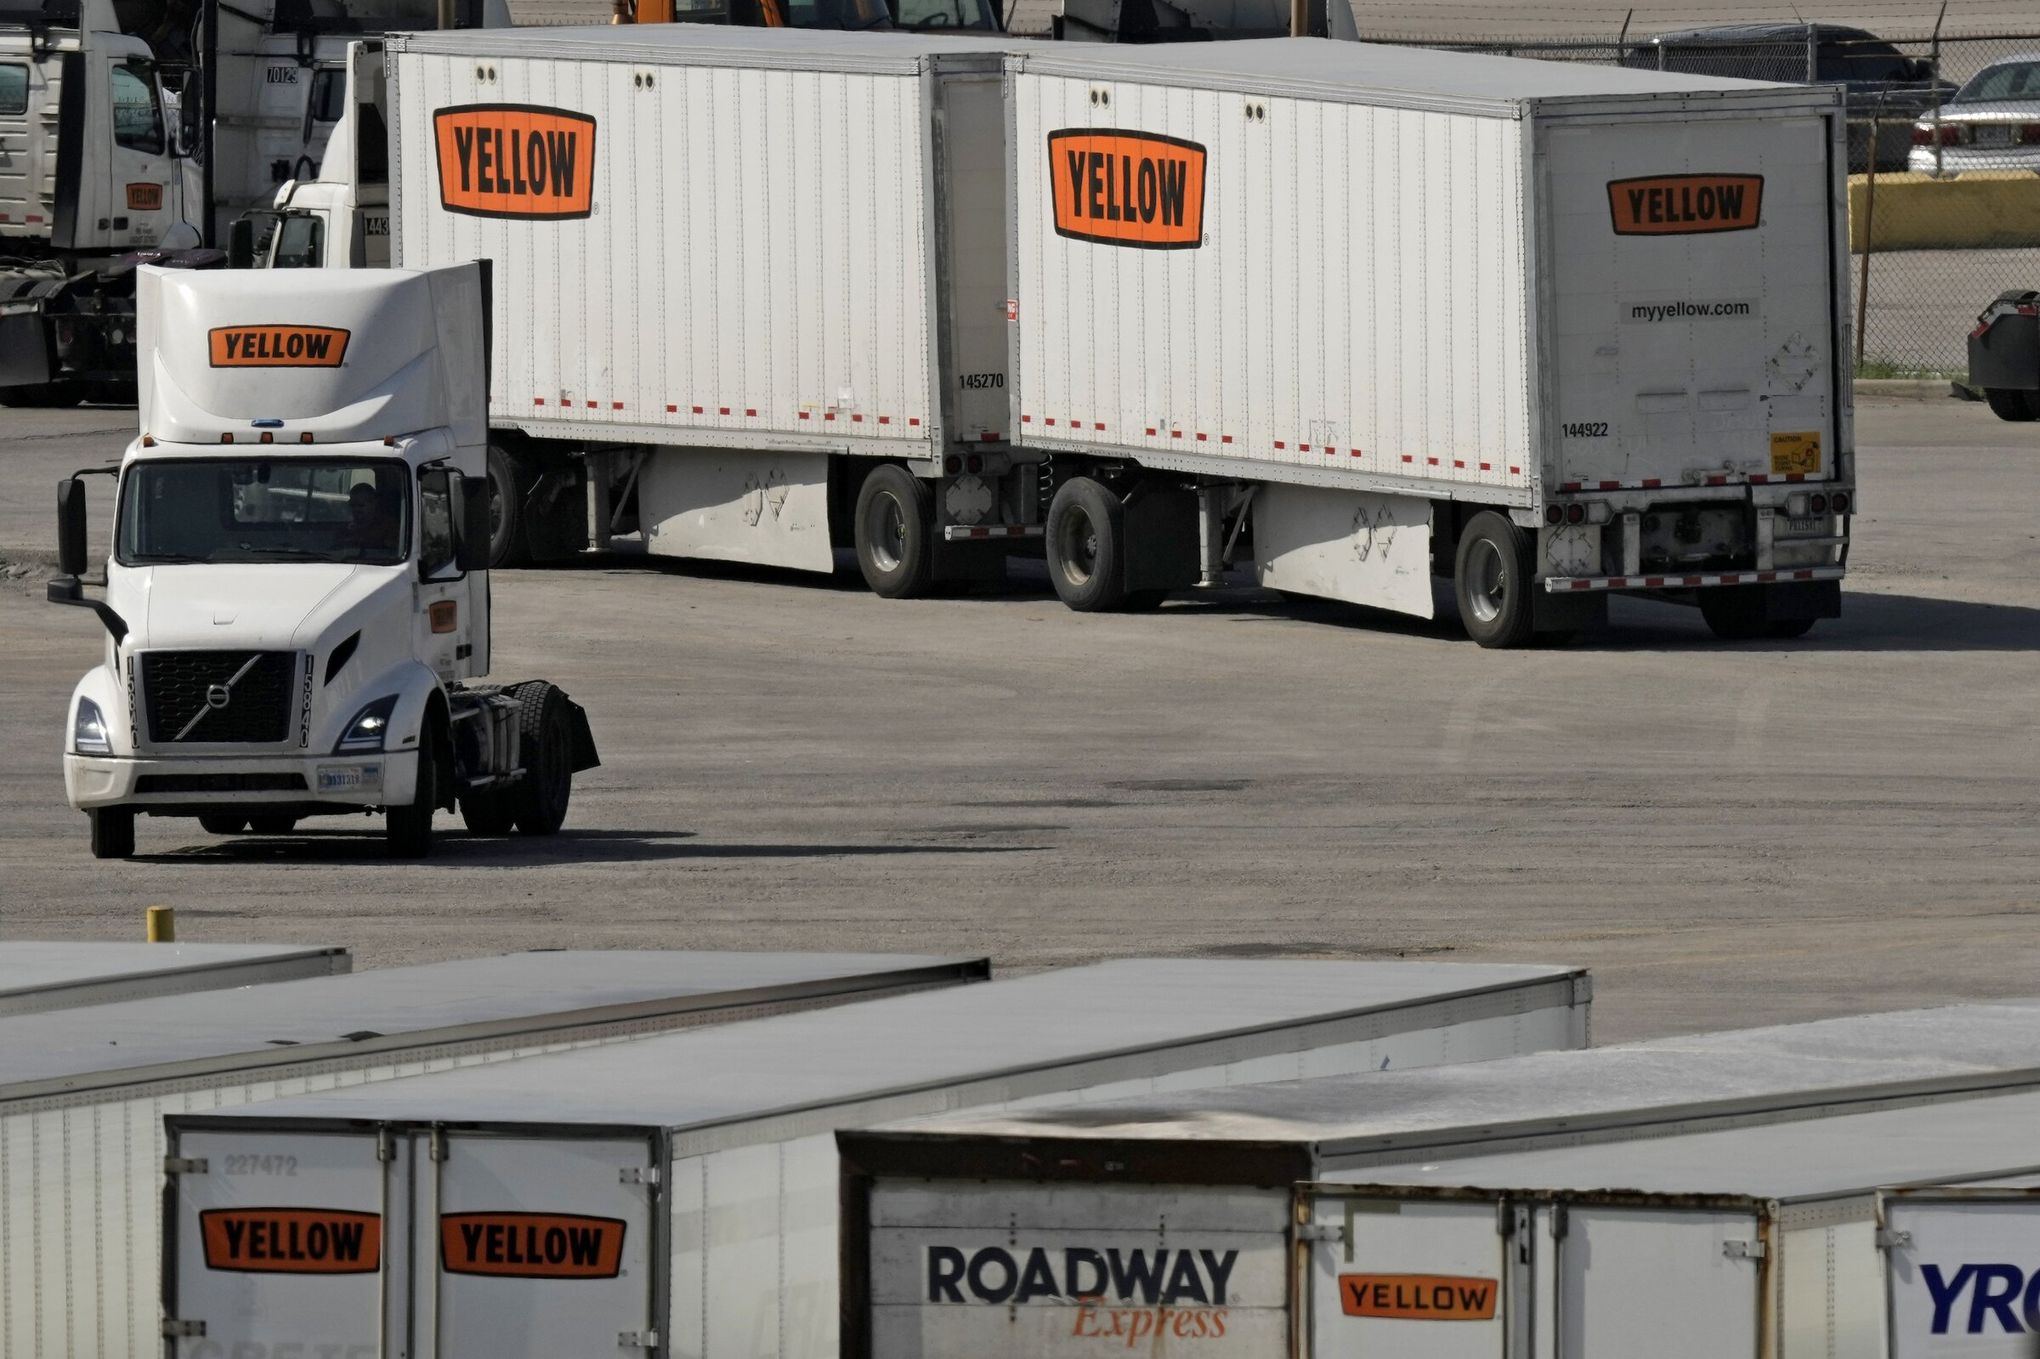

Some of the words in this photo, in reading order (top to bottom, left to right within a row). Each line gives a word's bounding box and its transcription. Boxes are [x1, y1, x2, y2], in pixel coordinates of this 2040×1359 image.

[454, 127, 577, 197] YELLOW
[1067, 150, 1187, 226] YELLOW
[1627, 185, 1744, 223] YELLOW
[1632, 302, 1749, 321] myyellow.com
[225, 333, 331, 359] YELLOW
[960, 373, 1004, 389] 145270
[1562, 422, 1608, 437] 144922
[127, 656, 140, 749] 15840
[300, 655, 314, 748] 15840
[224, 1155, 298, 1176] 227472
[224, 1220, 364, 1260] YELLOW
[461, 1224, 603, 1266] YELLOW
[928, 1246, 1240, 1305] ROADWAY
[1349, 1283, 1488, 1311] YELLOW
[1072, 1295, 1228, 1347] Express
